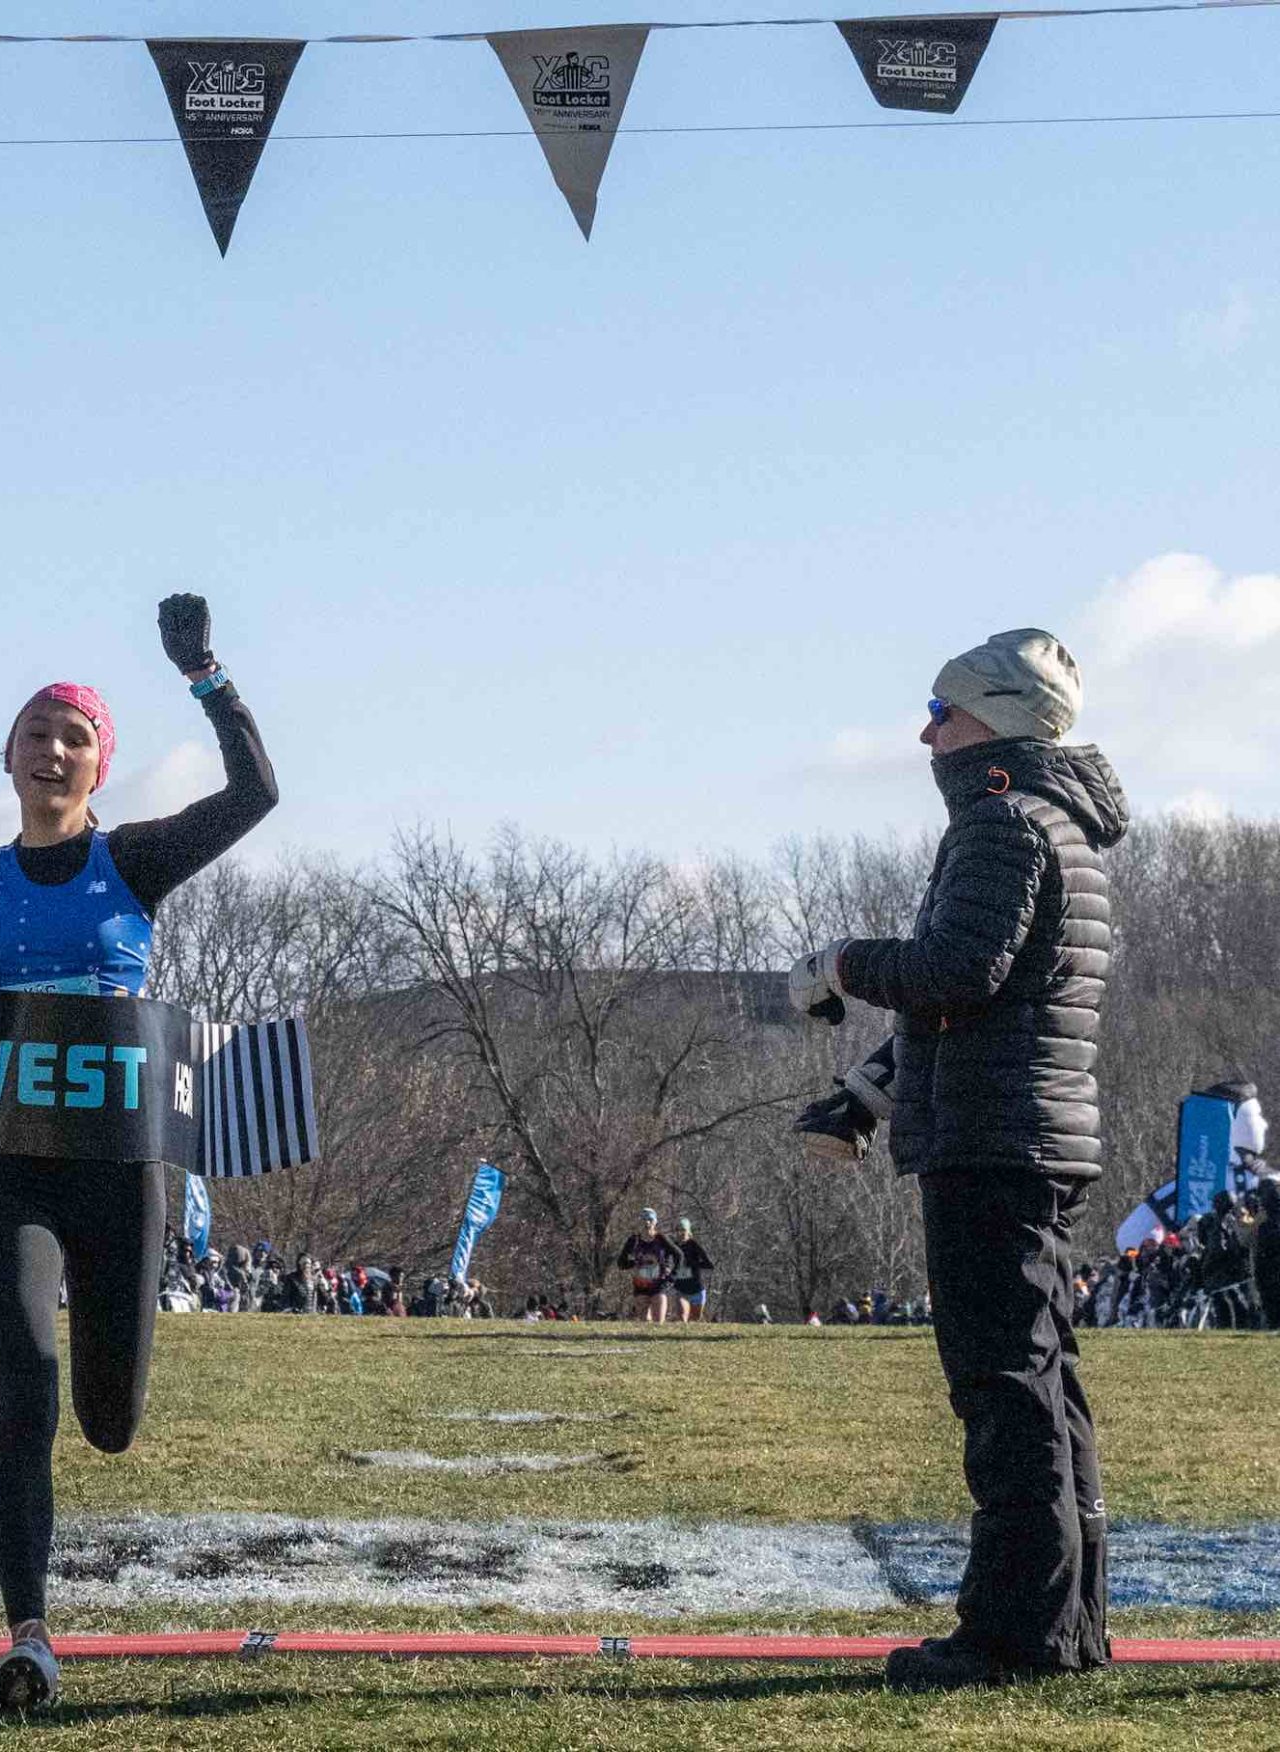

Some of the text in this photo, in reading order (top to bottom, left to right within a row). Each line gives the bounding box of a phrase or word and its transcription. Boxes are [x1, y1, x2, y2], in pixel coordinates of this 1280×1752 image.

[879, 66, 953, 80] Foot Locker
[189, 96, 261, 109] Foot Locker
[535, 92, 607, 105] Foot Locker
